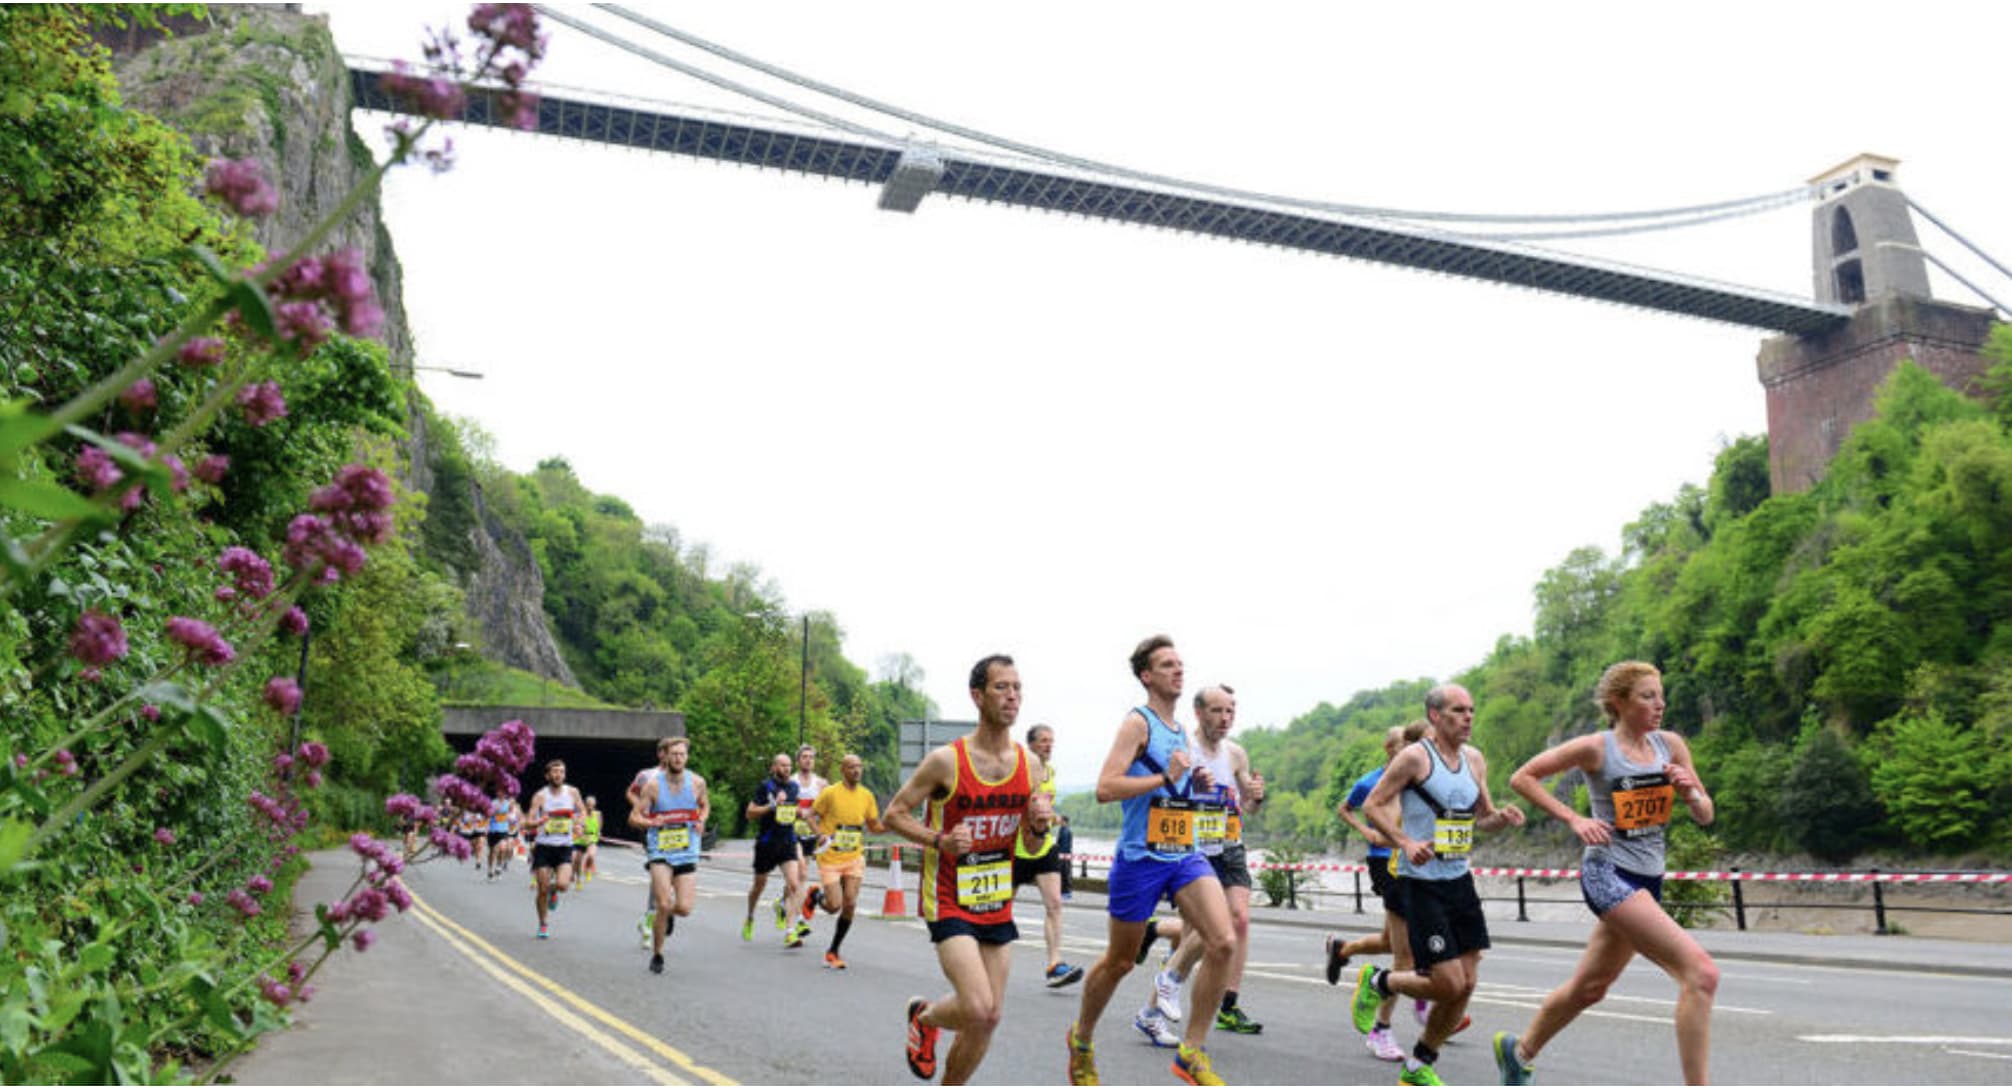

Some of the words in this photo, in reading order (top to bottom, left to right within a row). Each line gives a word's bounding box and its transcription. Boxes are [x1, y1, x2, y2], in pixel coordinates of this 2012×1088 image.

[1622, 797, 1667, 819] 2707
[1160, 818, 1186, 835] 618
[971, 873, 998, 894] 211
